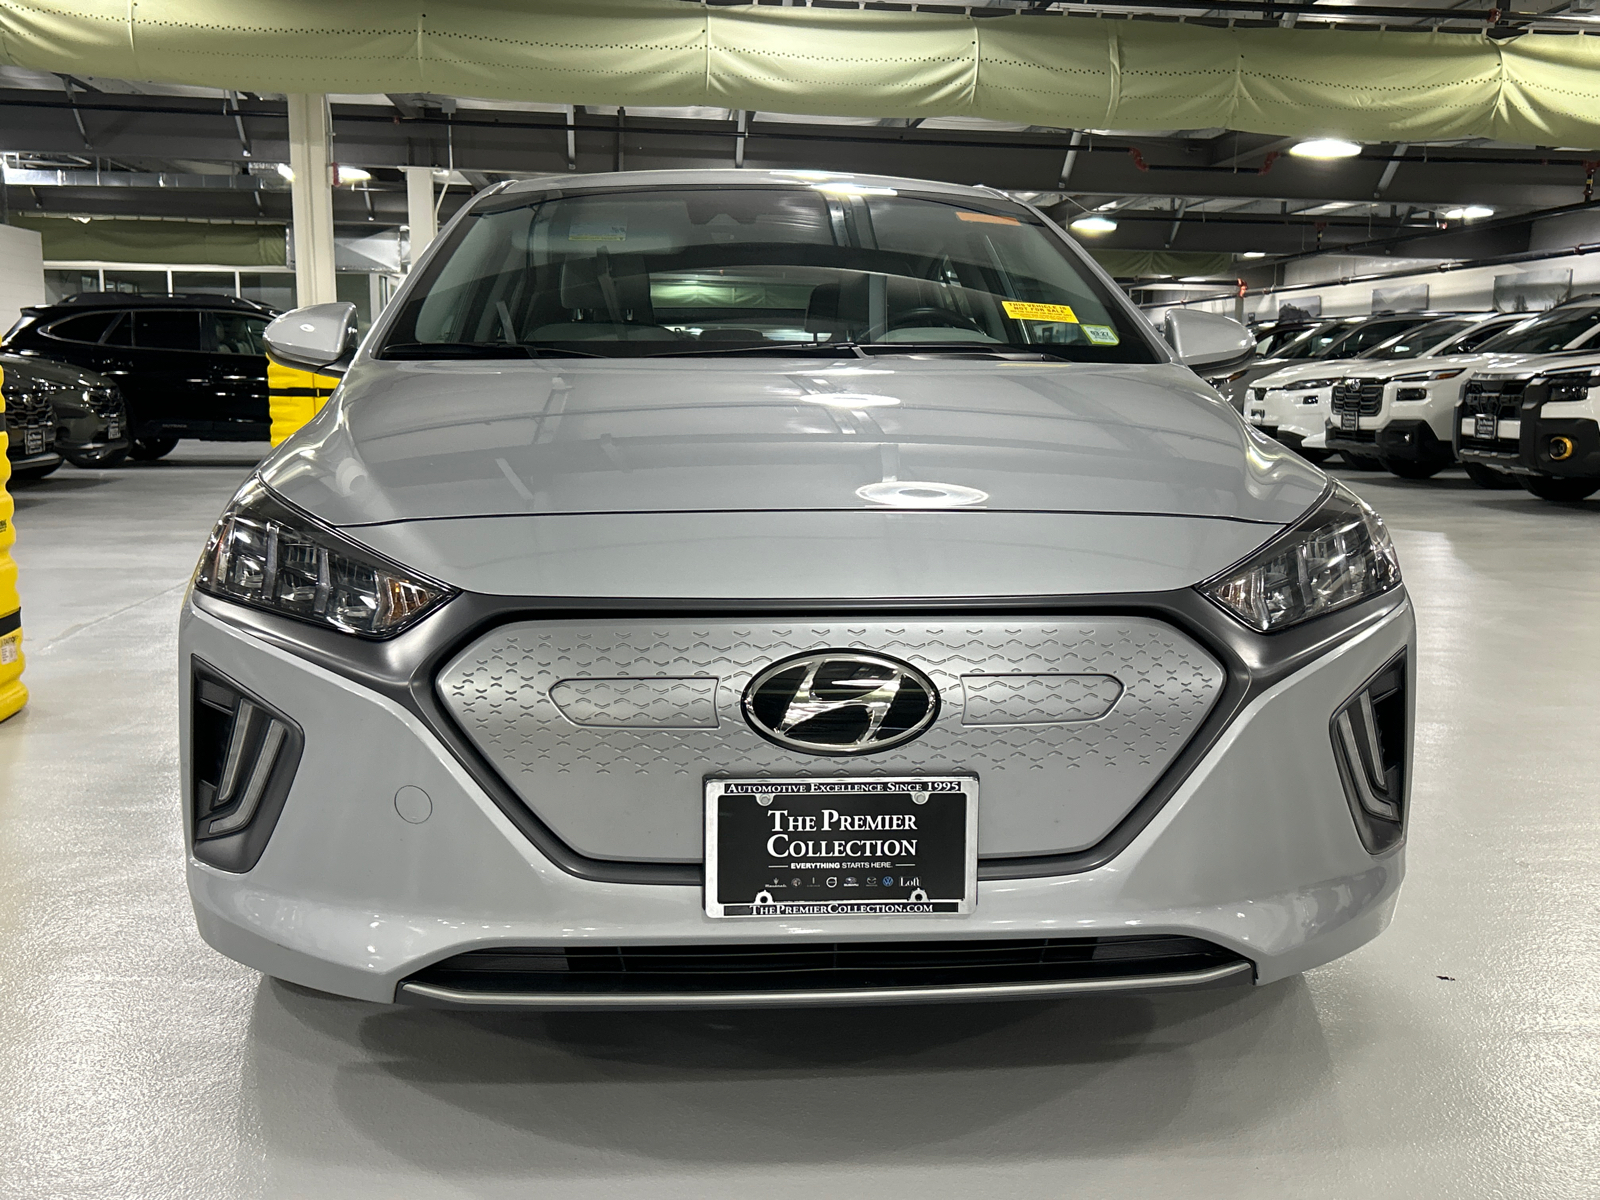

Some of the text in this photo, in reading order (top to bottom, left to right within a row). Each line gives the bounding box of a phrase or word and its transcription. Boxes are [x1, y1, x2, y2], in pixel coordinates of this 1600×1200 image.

[927, 781, 959, 792] 1995
[790, 862, 841, 870] EVERYTHING
[841, 861, 870, 869] STARTS
[900, 876, 920, 887] Loft
